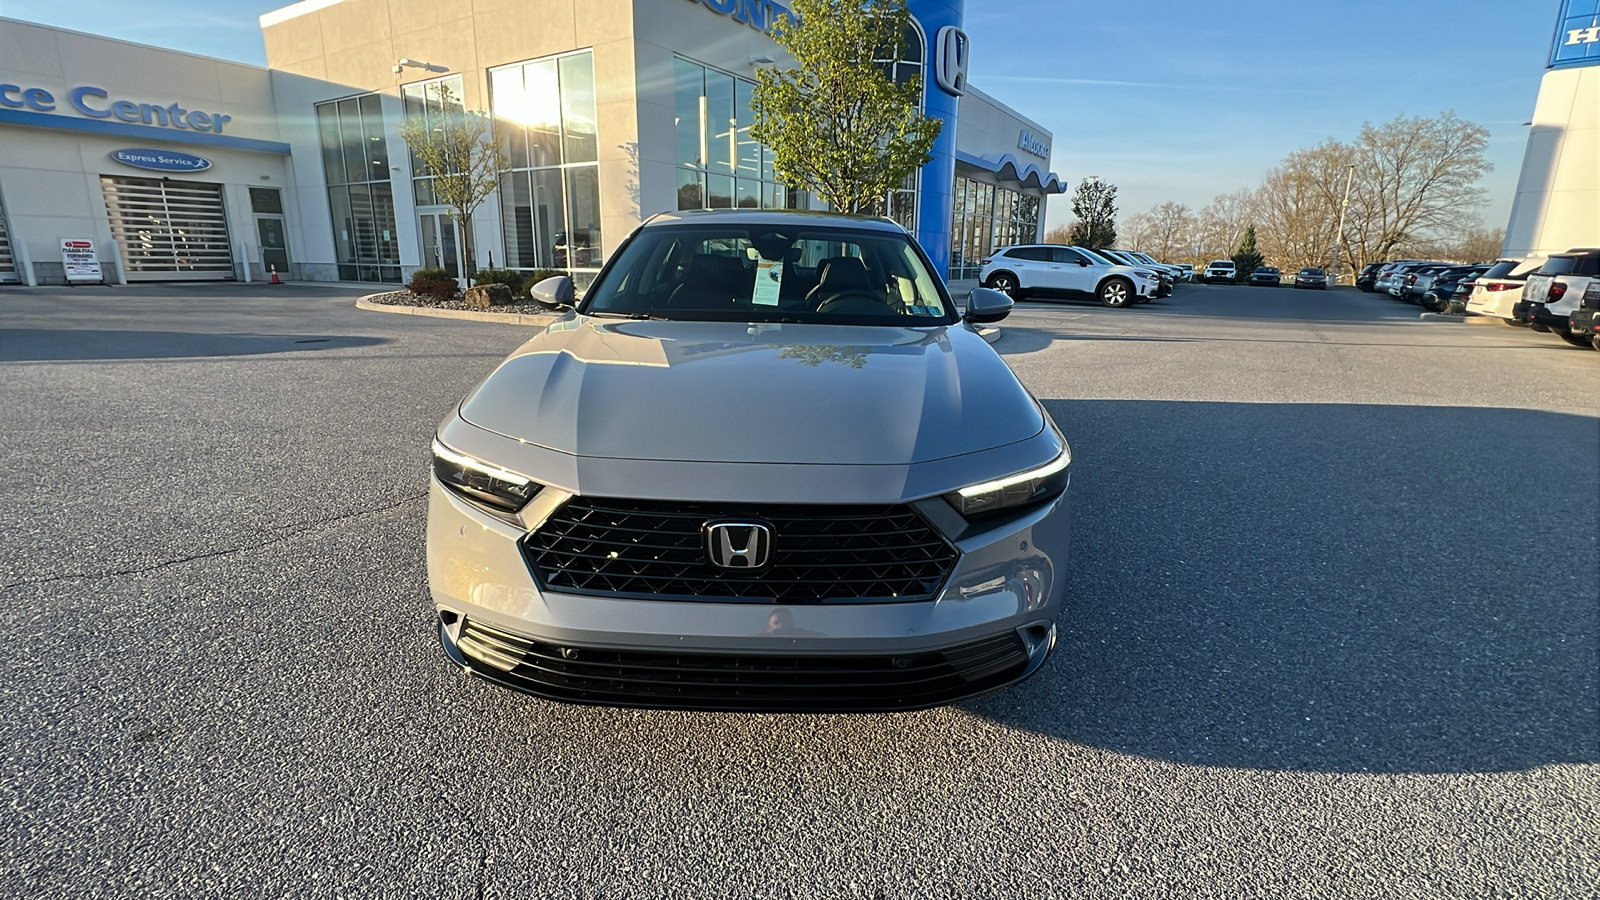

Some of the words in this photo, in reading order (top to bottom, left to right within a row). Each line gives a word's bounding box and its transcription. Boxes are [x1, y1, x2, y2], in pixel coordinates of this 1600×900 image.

[70, 85, 232, 133] Center
[118, 152, 156, 163] Express
[158, 156, 194, 166] Service
